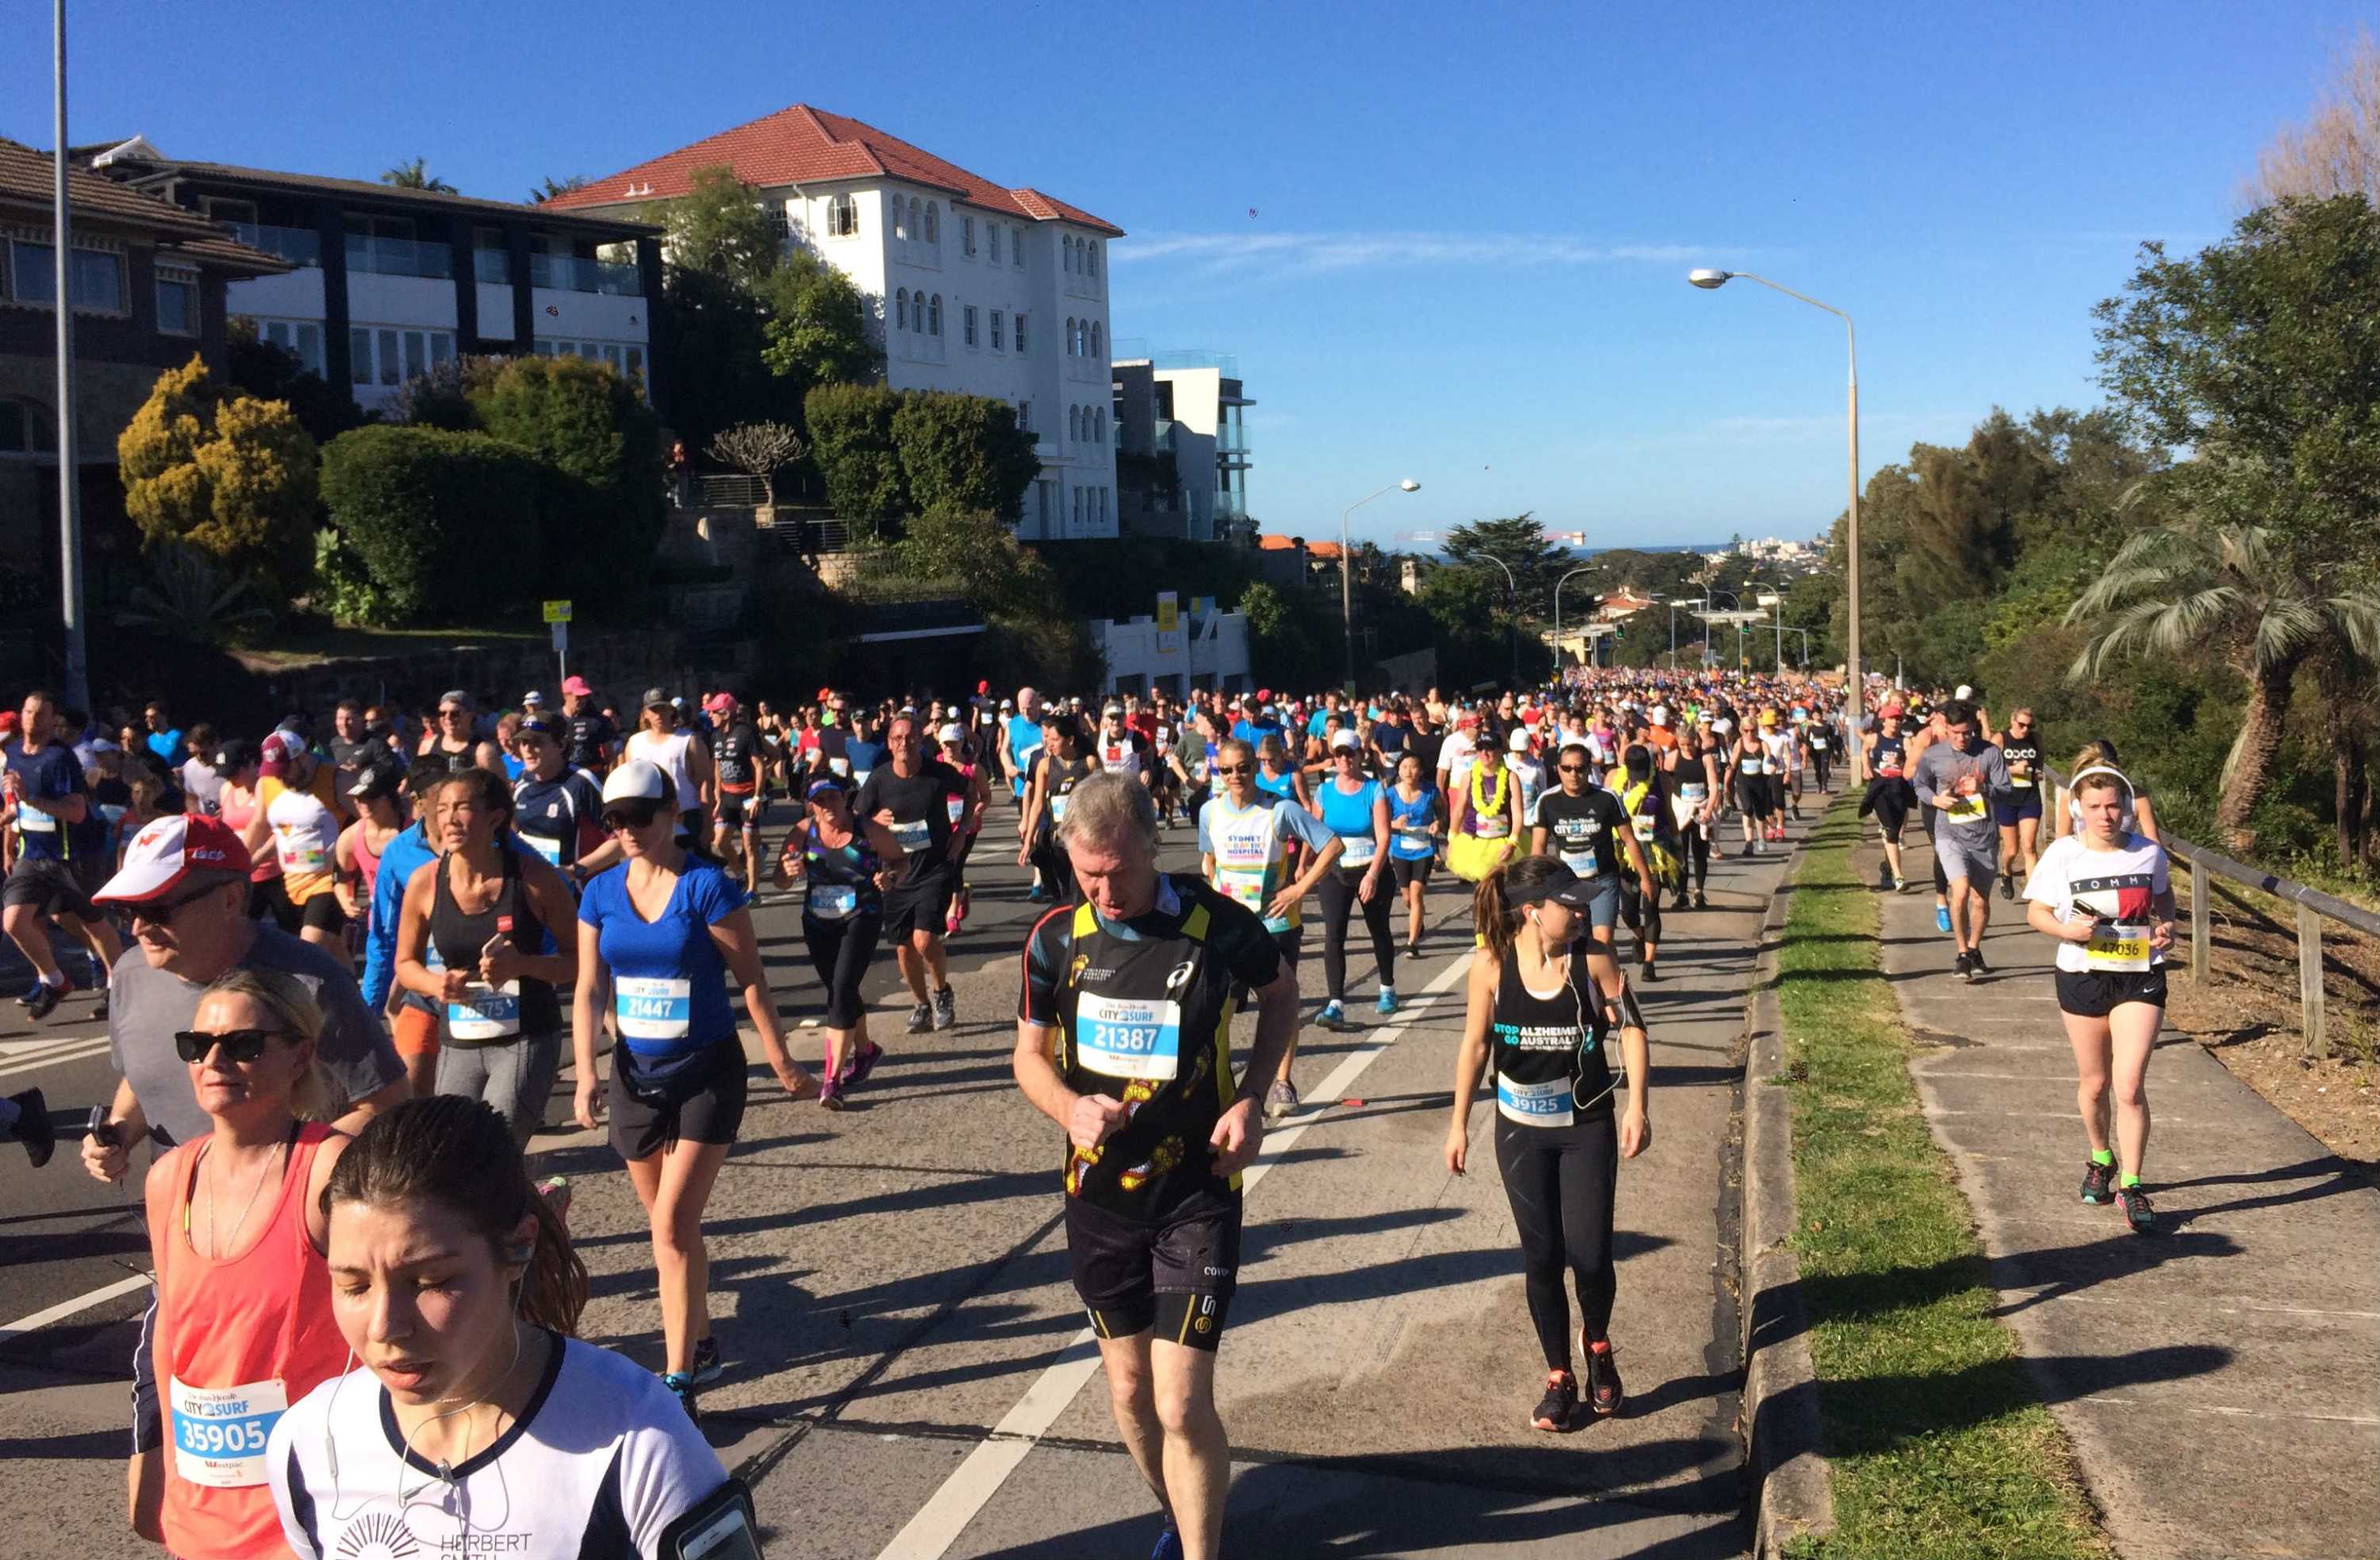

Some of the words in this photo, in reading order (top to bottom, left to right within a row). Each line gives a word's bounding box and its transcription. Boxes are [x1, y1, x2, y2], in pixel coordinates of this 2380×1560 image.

[2101, 943, 2140, 955] 47036
[628, 998, 674, 1018] 21447
[1099, 1009, 1154, 1022] CITY2SURF
[1095, 1024, 1157, 1050] 21387
[1494, 1023, 1520, 1035] STOP
[1503, 1035, 1519, 1045] GO
[1510, 1095, 1559, 1112] 39125
[184, 1399, 249, 1417] CITY2SURF
[182, 1420, 265, 1452] 35905
[205, 1459, 244, 1470] Westpac
[440, 1533, 533, 1552] HERBERT
